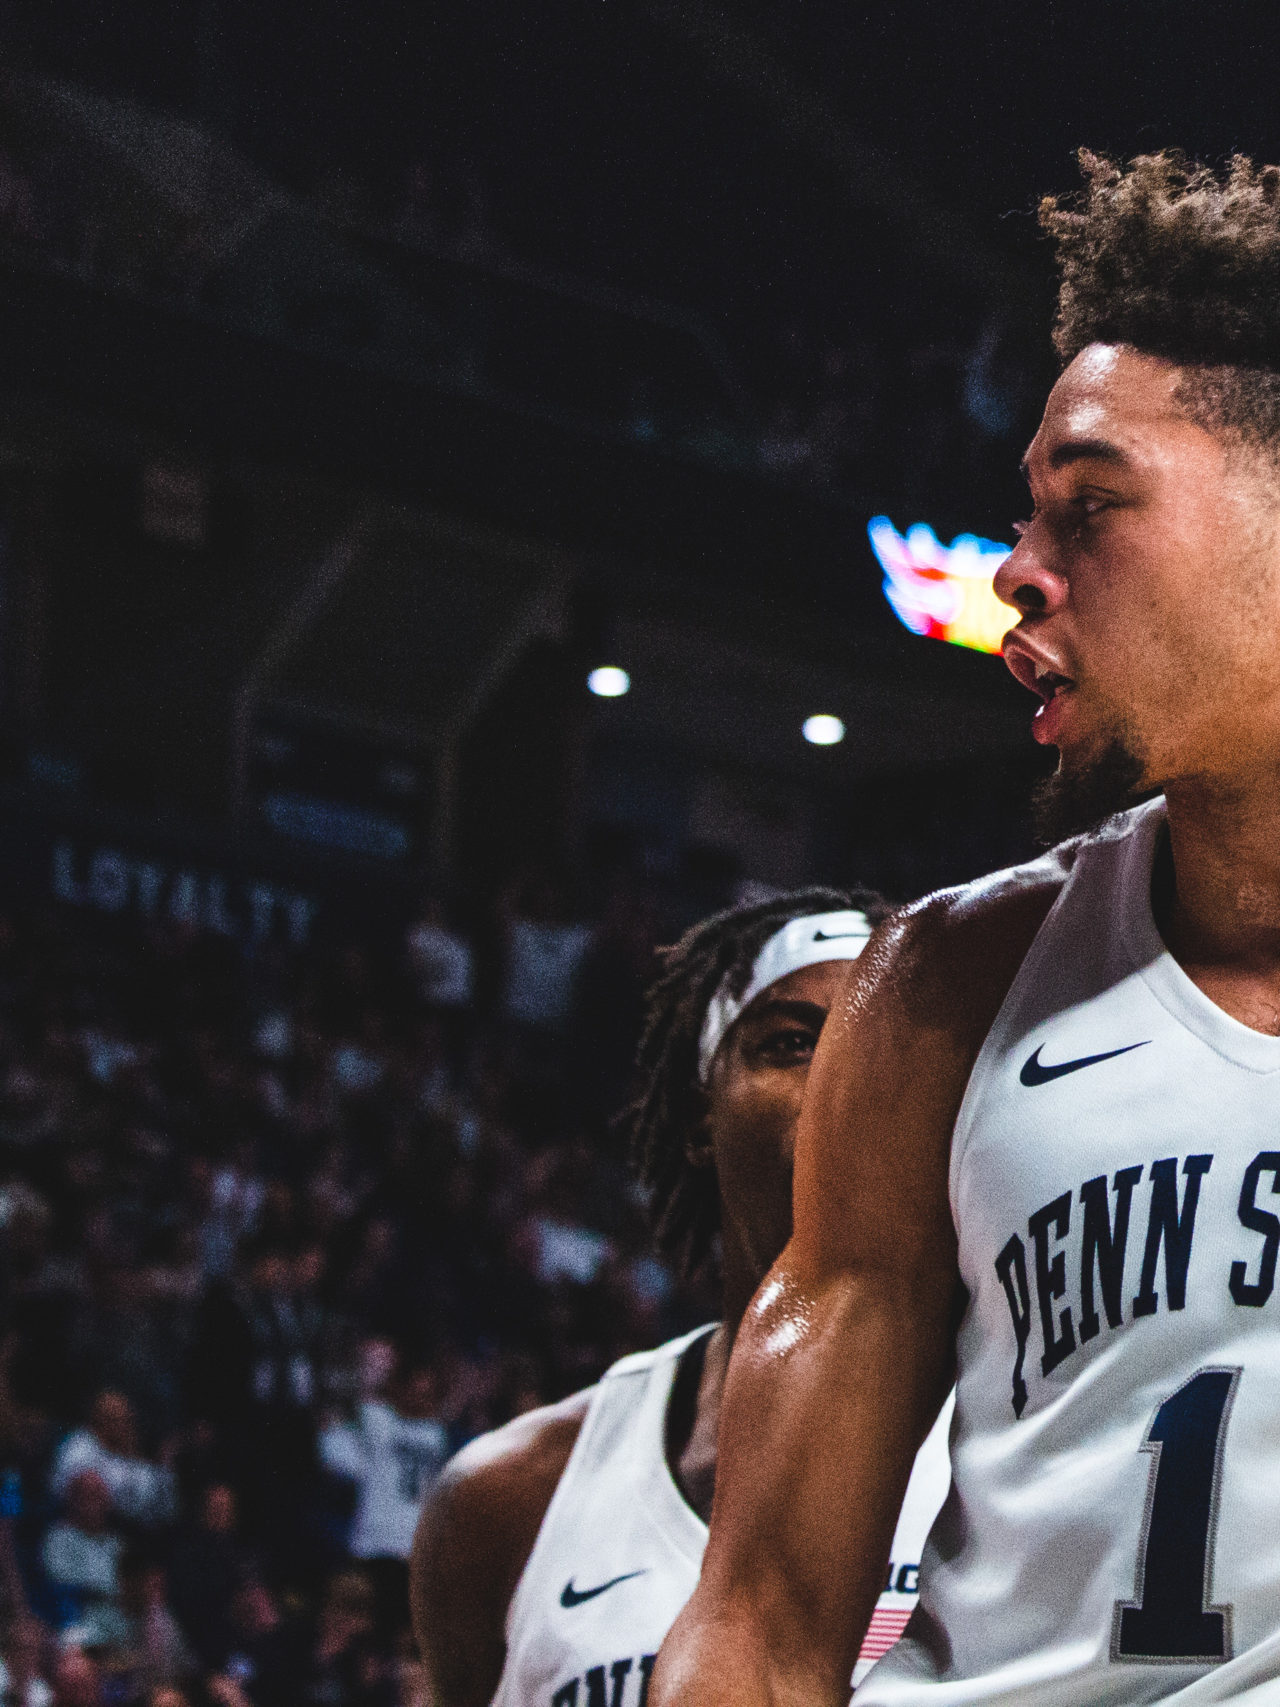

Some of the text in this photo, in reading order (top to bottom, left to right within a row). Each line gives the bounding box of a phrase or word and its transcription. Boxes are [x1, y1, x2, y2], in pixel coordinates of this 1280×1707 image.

[51, 836, 318, 944] LOYALTY
[994, 1153, 1213, 1420] PENN
[1109, 1364, 1244, 1665] 1
